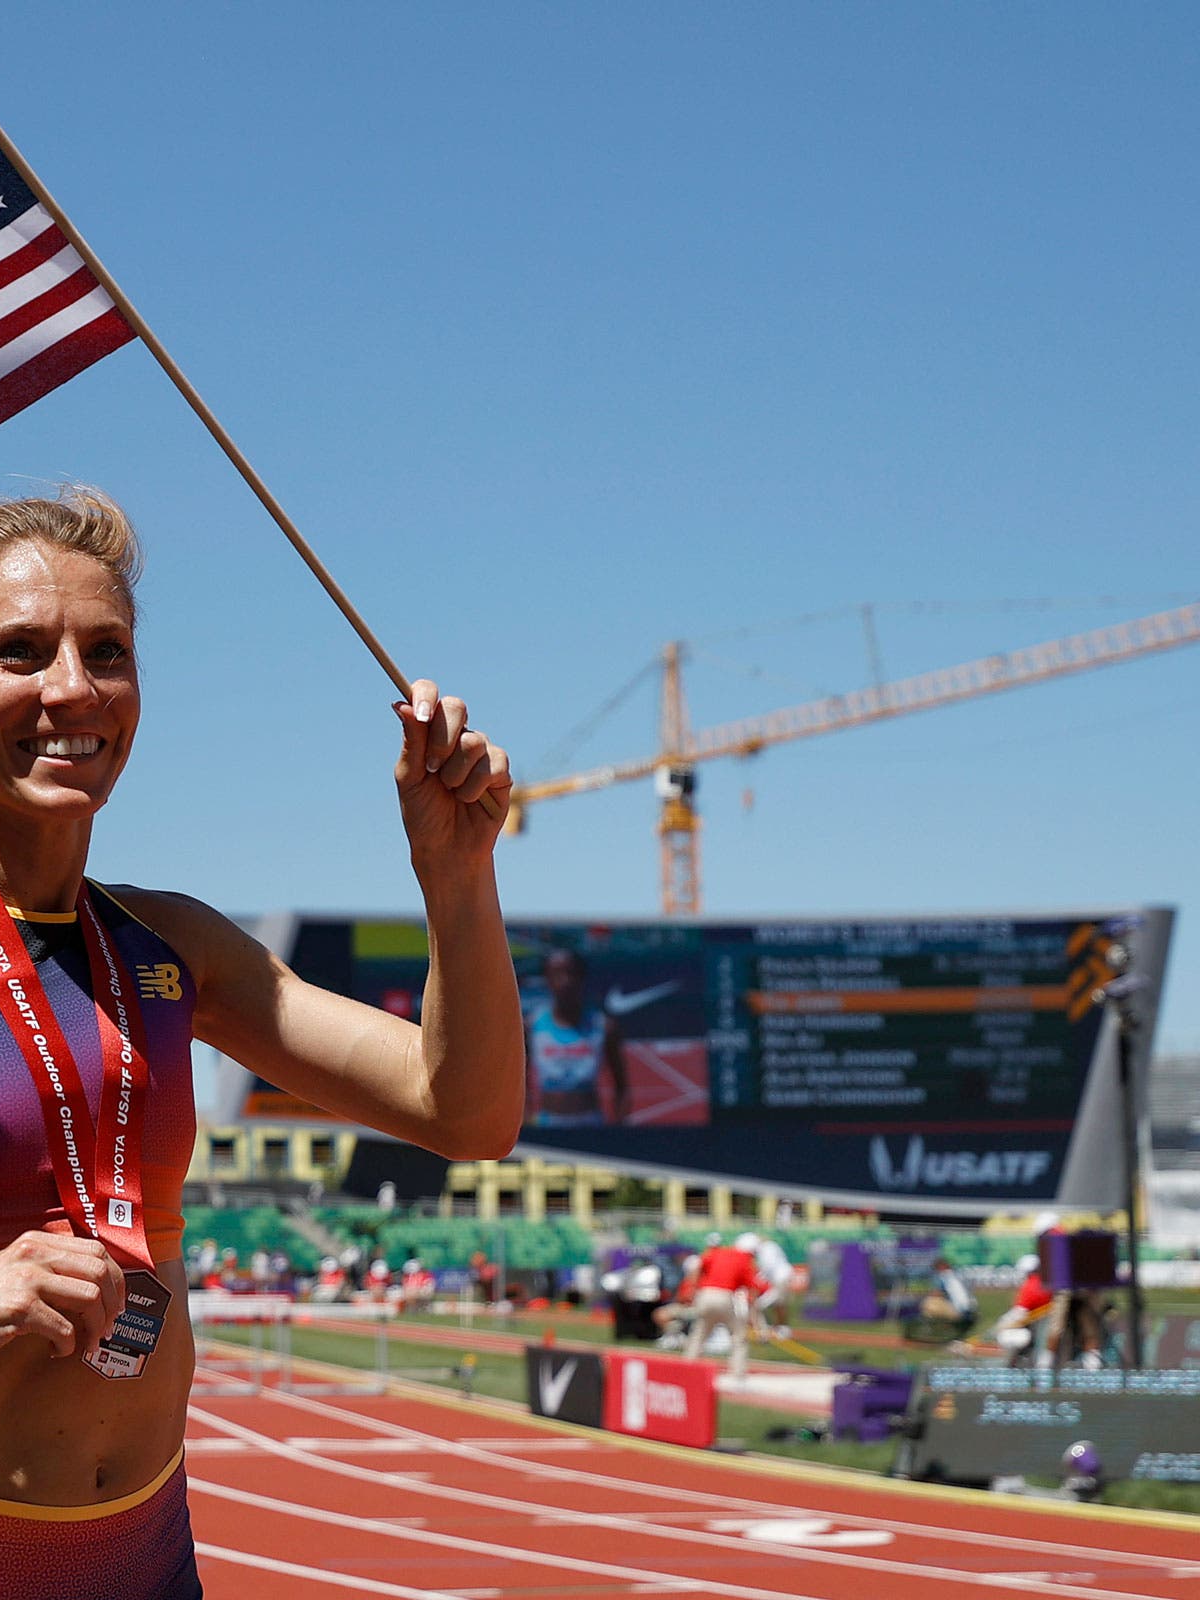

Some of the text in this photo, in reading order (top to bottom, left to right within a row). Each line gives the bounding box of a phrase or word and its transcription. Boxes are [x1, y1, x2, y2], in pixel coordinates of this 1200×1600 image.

[7, 978, 40, 1030] USATF
[33, 1034, 66, 1101] Outdoor
[83, 898, 133, 1194] TOYOTA USATF Outdoor Champions
[922, 1150, 1053, 1186] USATF
[128, 1293, 156, 1307] USATF
[121, 1313, 154, 1328] OUTDOOR
[109, 1356, 130, 1368] TOYOTA
